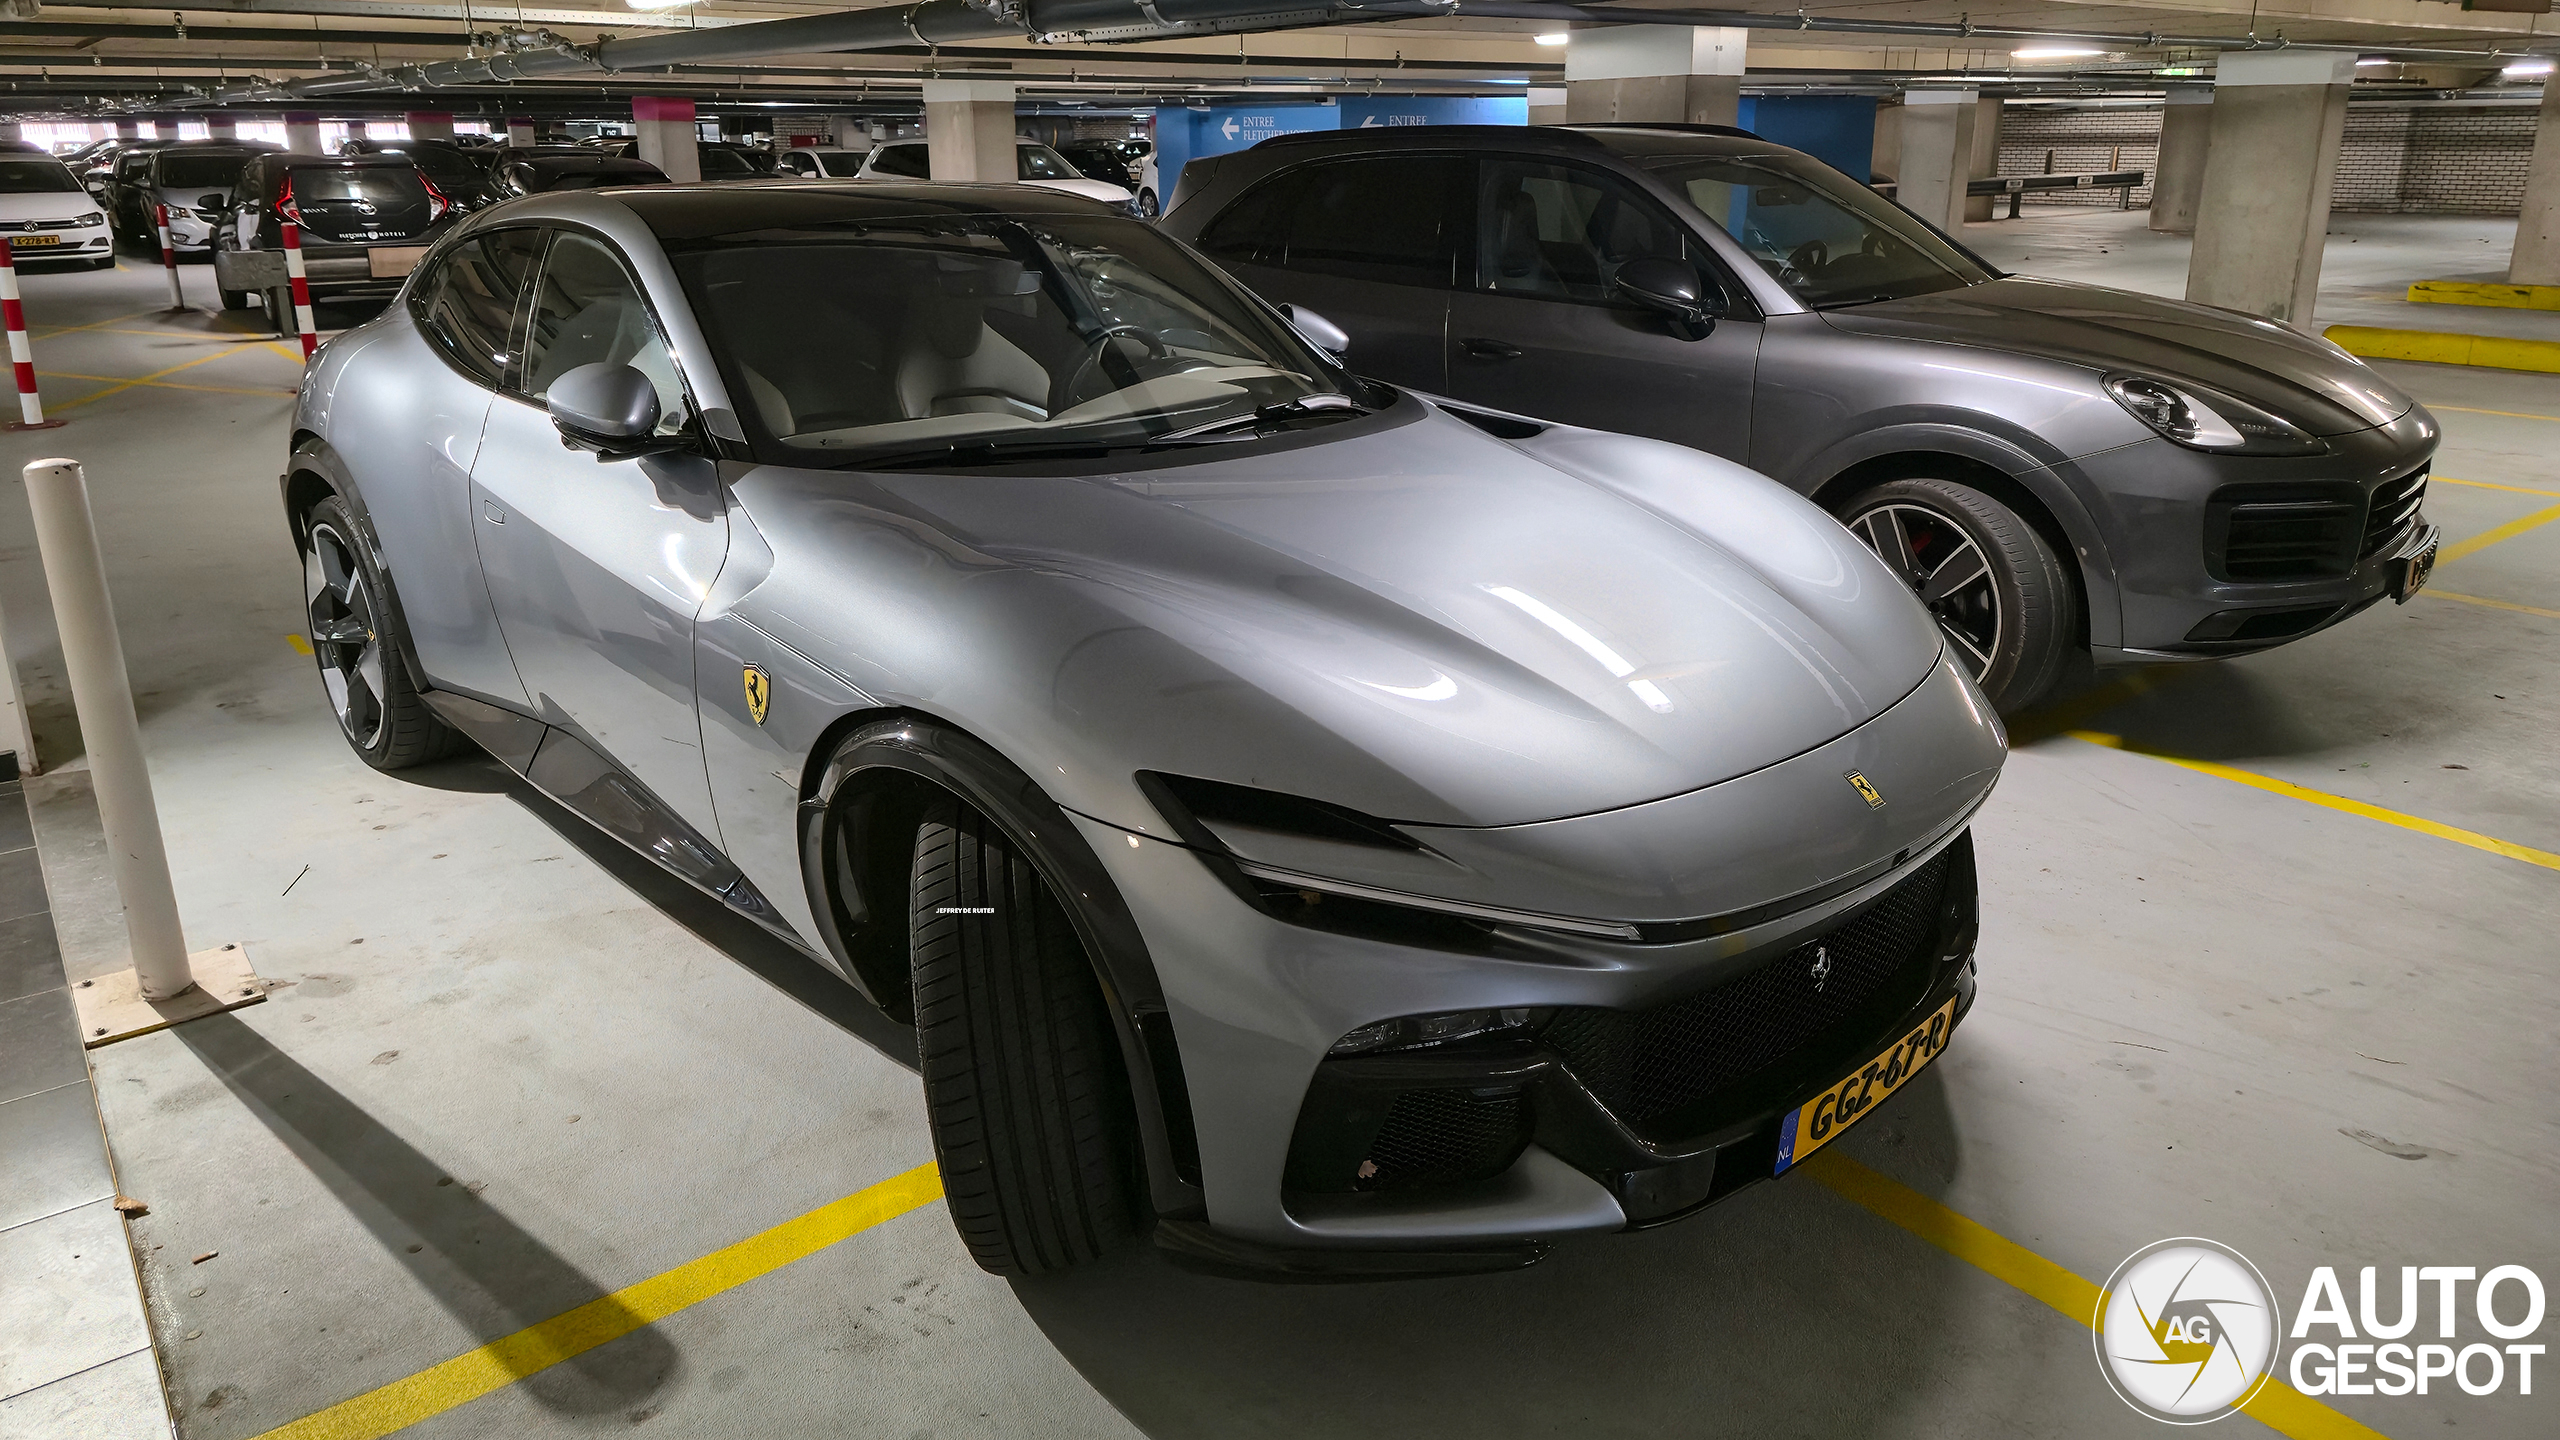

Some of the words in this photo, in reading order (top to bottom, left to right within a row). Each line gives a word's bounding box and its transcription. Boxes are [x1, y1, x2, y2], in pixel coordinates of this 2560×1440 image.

[1243, 116, 1275, 127] ENTREE
[1389, 115, 1427, 127] ENTREE
[1810, 1011, 1947, 1140] GGZ-67-R
[1776, 1145, 1792, 1163] NL
